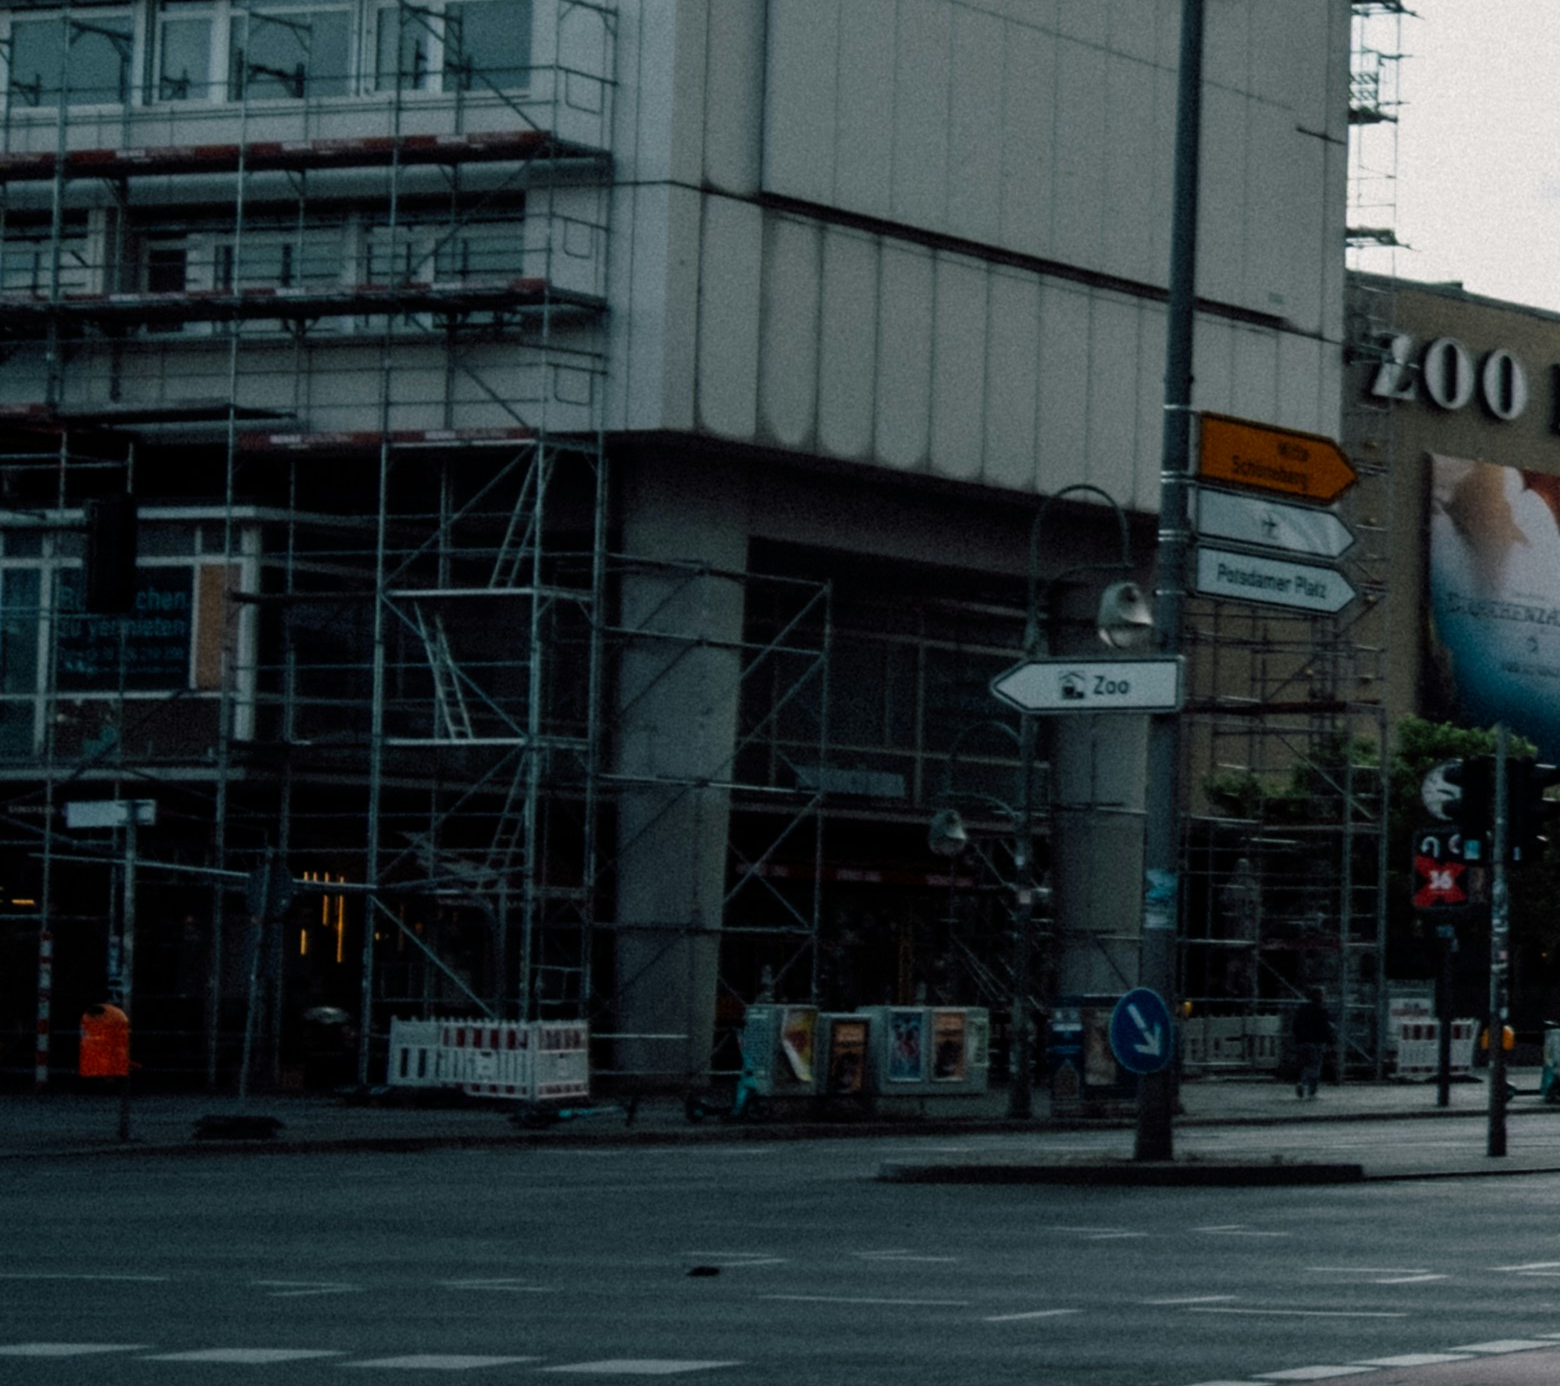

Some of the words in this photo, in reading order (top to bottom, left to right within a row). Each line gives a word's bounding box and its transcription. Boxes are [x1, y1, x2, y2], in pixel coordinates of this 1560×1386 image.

[1371, 334, 1528, 421] ZOO
[1216, 562, 1292, 593] Potsdamer
[1293, 575, 1328, 599] Platz
[1093, 675, 1130, 695] Zoo
